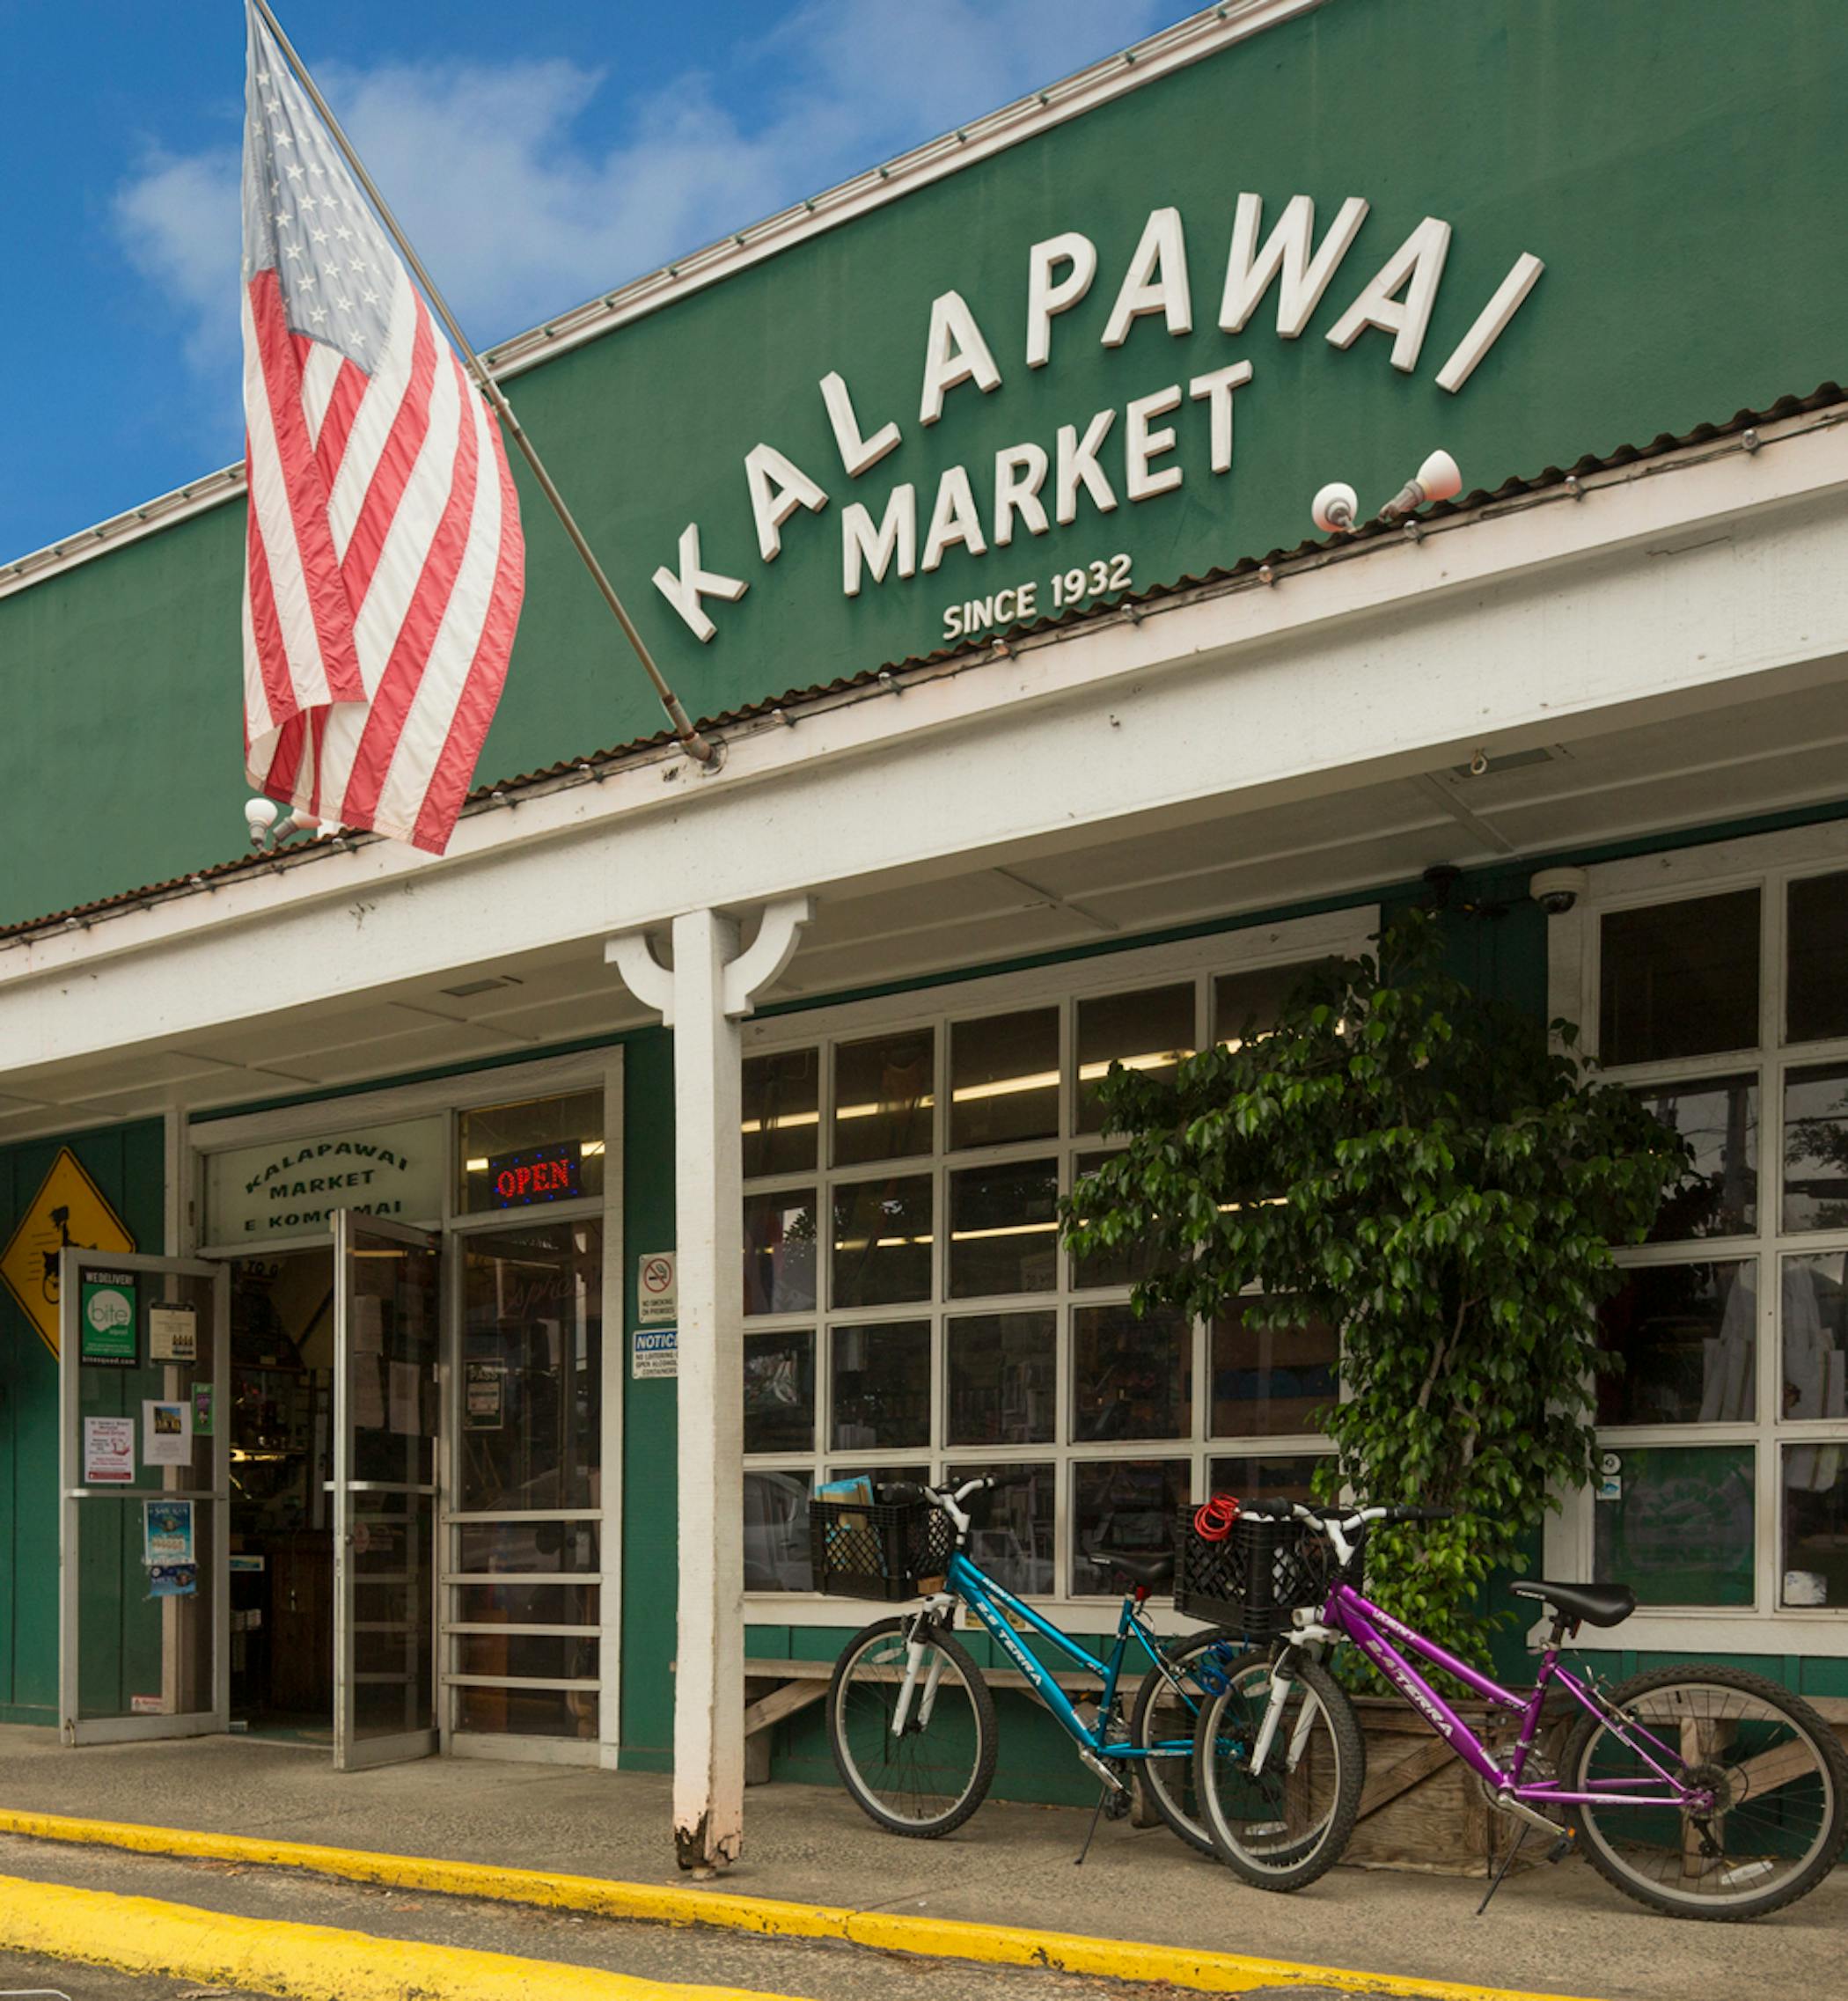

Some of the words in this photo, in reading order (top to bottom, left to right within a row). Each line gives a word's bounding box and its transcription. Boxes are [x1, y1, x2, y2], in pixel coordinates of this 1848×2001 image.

[651, 192, 1544, 643] KALAPAWAI
[841, 359, 1253, 597] MARKET
[942, 582, 1038, 641] SINCE
[1050, 553, 1133, 609] 1932
[245, 1142, 409, 1195] KALAPAWAI
[269, 1169, 377, 1200] MARKET
[496, 1159, 570, 1199] OPEN
[245, 1220, 256, 1232] E
[92, 1295, 128, 1323] bite
[637, 1333, 677, 1349] NOTIC
[999, 1629, 1042, 1687] TERRA
[1395, 1668, 1454, 1738] TERRA
